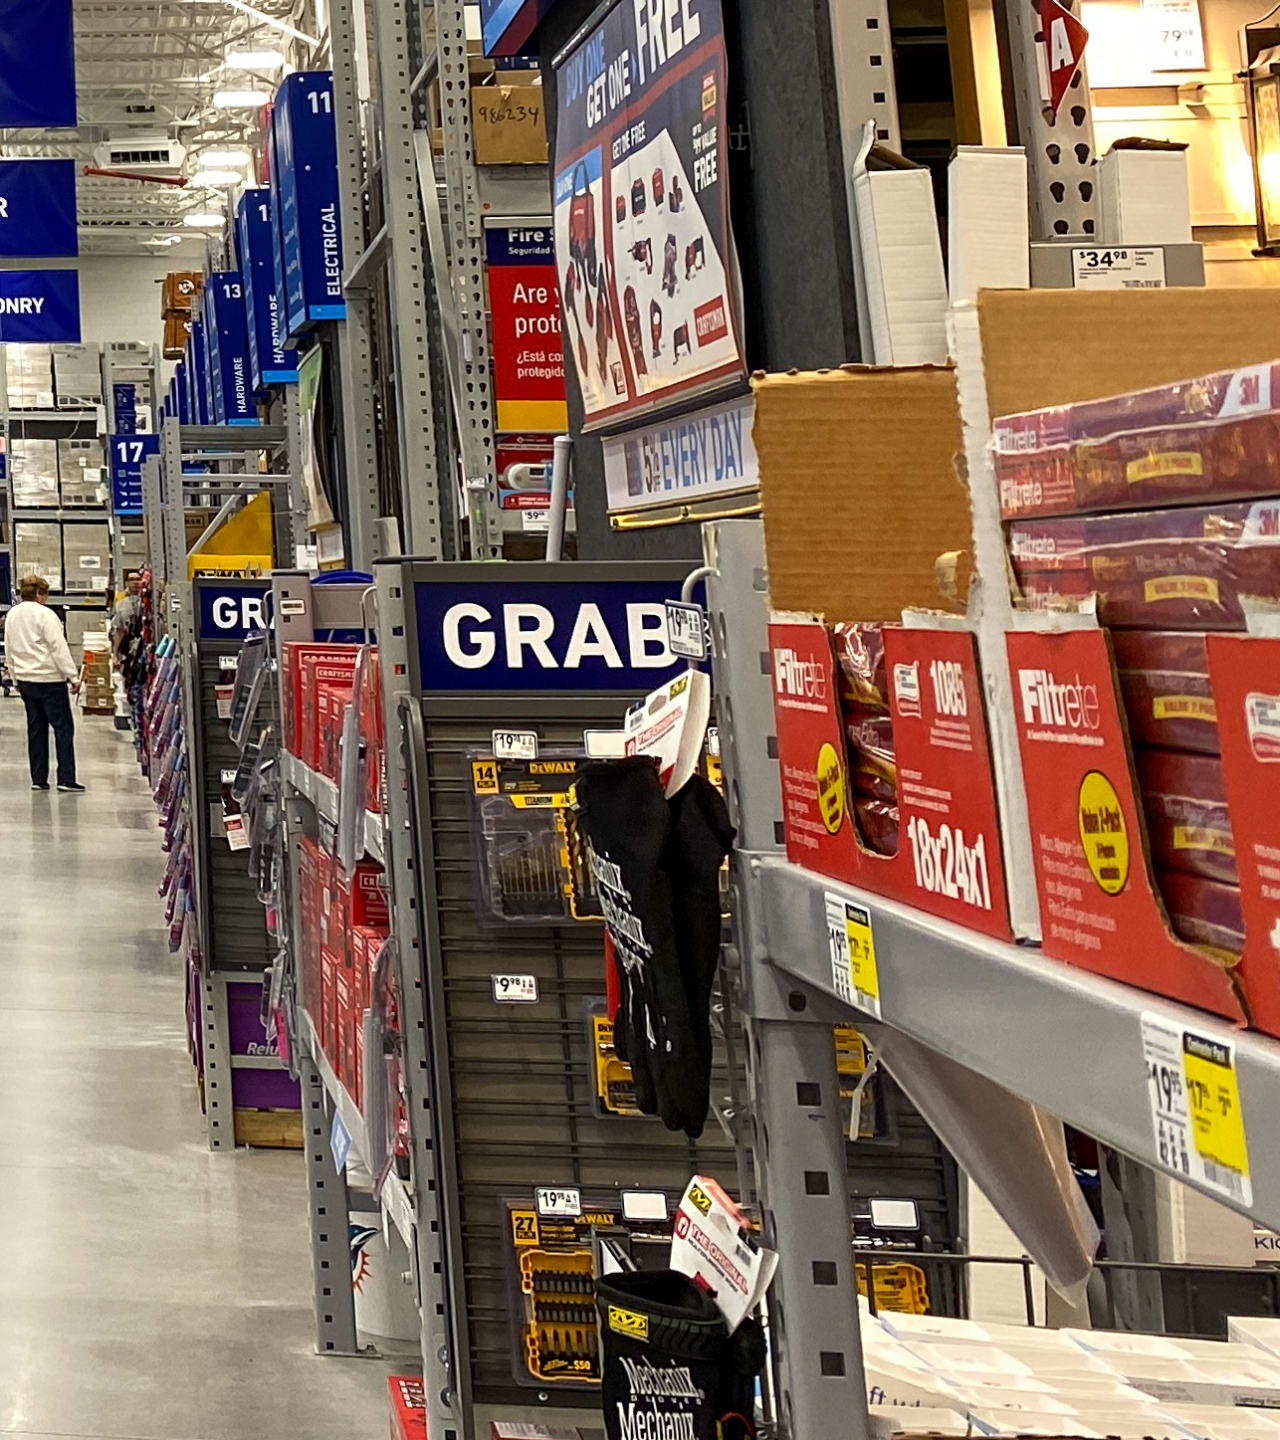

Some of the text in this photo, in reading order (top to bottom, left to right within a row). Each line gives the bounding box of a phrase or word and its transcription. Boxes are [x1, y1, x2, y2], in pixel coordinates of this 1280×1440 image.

[585, 28, 607, 85] ONE
[1050, 16, 1075, 72] A
[307, 90, 332, 114] 11
[586, 48, 633, 130] GET ONE
[693, 148, 718, 193] FREE
[321, 202, 342, 296] ELECTRICAL
[507, 227, 544, 243] Fire
[507, 245, 550, 257] Seguridad
[223, 283, 241, 299] 13
[512, 281, 549, 305] Are
[516, 350, 546, 365] ¿Está
[234, 356, 247, 414] HARDWARE
[1239, 375, 1260, 406] 3M
[117, 442, 144, 463] 17
[661, 410, 744, 491] EVERY DAY
[1258, 507, 1279, 536] 3M
[212, 595, 276, 629] GR
[442, 601, 679, 669] GRAB
[773, 648, 826, 699] Filtrete
[929, 659, 967, 716] 1085
[1017, 668, 1100, 730] Filtrete
[476, 766, 493, 781] 14
[907, 815, 992, 911] 18x24x1
[514, 1216, 535, 1232] 27
[690, 1221, 713, 1252] THE
[618, 1356, 698, 1399] Mechanix
